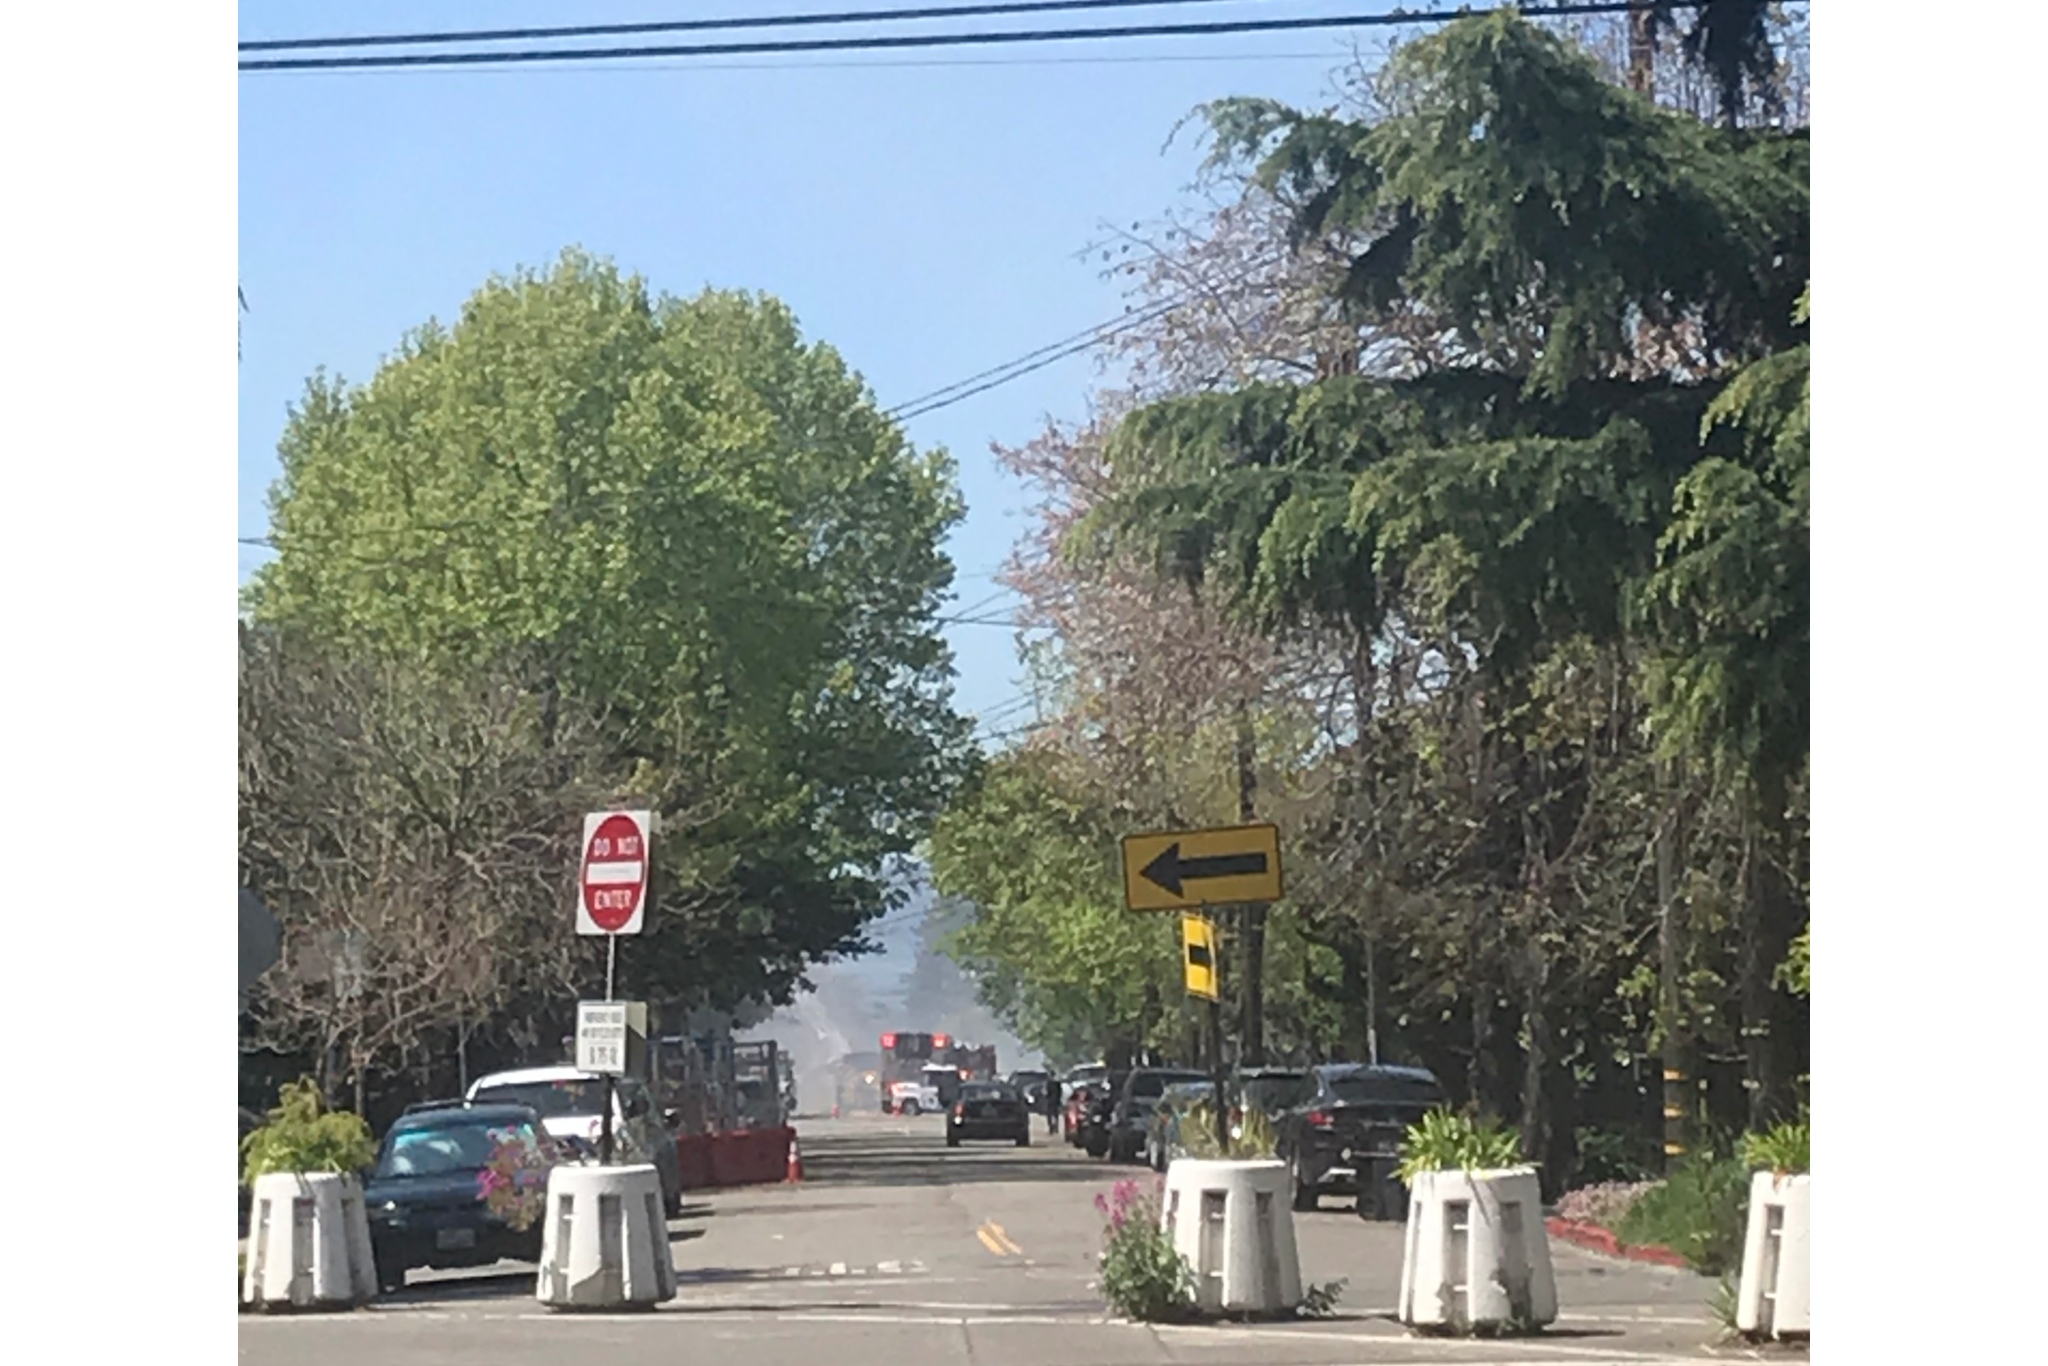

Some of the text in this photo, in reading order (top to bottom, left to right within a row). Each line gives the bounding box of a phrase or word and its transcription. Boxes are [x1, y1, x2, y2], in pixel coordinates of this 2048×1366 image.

[594, 836, 639, 857] DO NOT
[594, 889, 632, 910] ENTER
